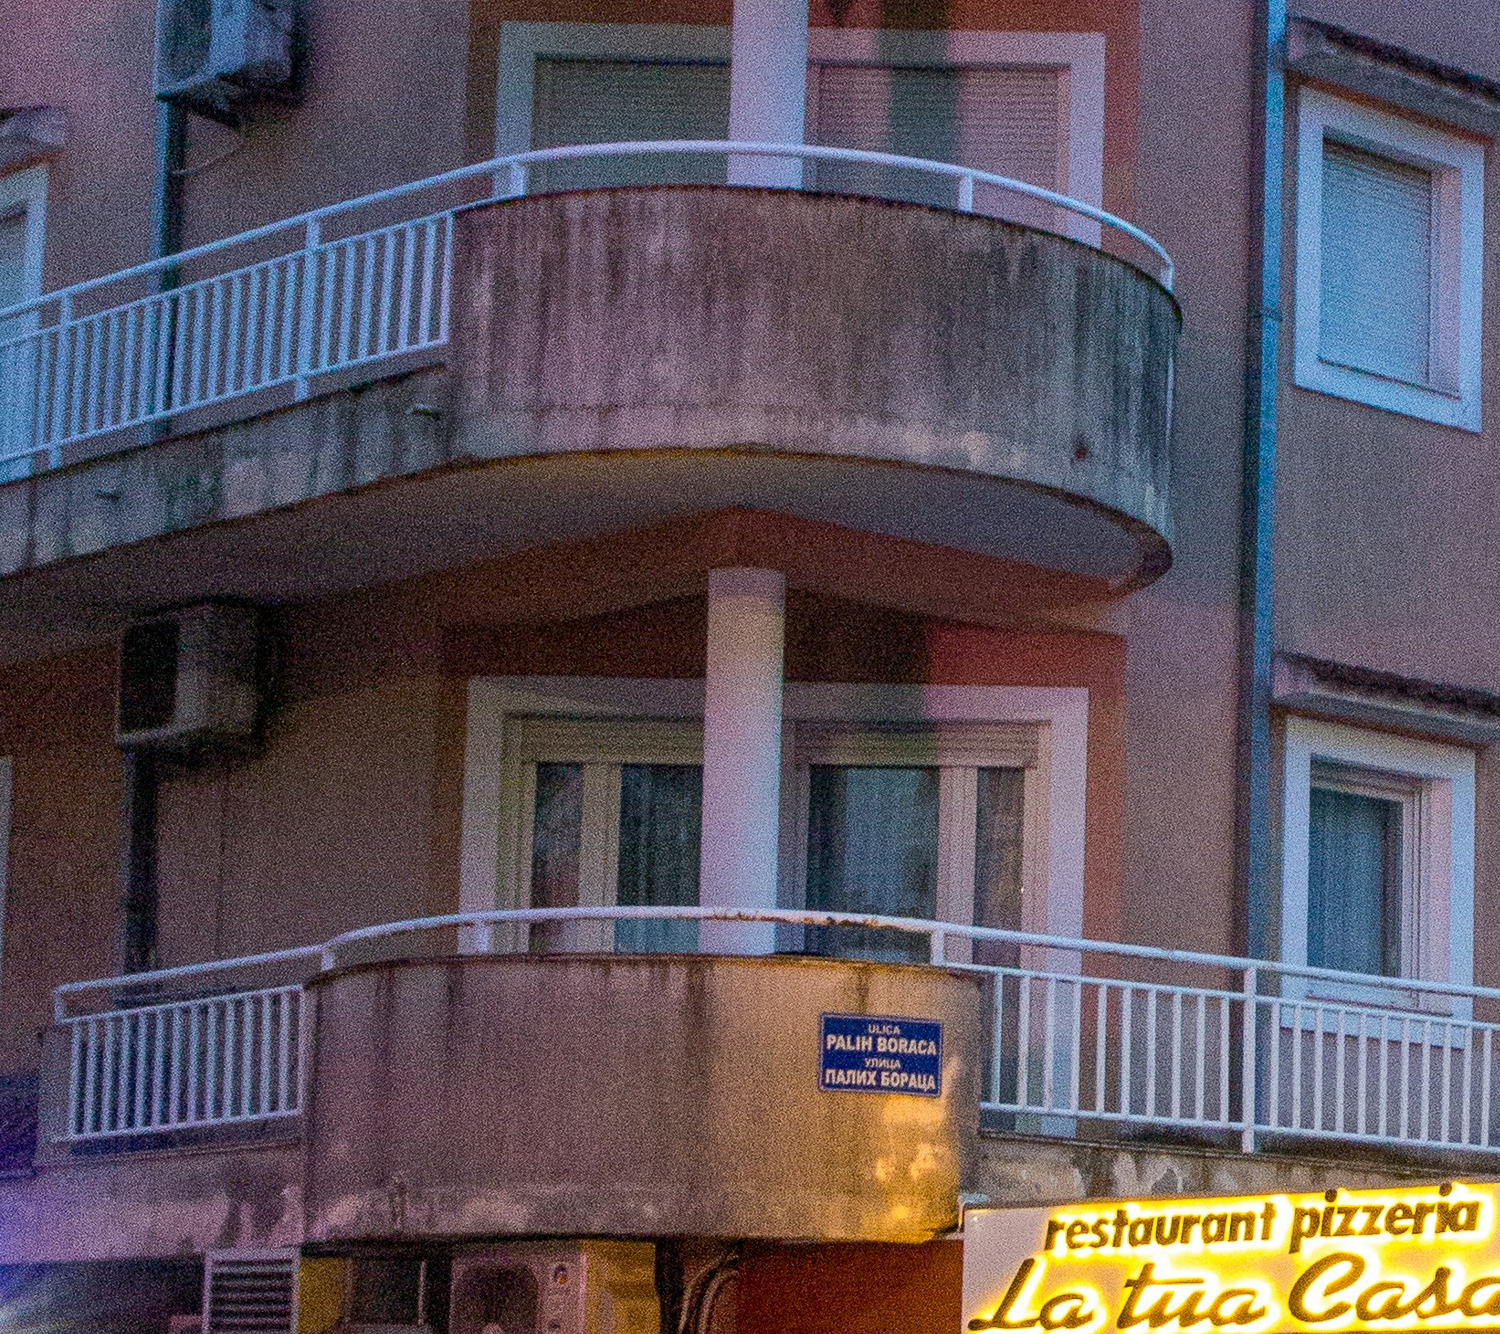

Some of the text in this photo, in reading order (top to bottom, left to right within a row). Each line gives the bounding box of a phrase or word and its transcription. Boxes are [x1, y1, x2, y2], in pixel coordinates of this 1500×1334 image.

[868, 1024, 900, 1035] ULICA
[826, 1034, 937, 1056] PALIH BORACA
[864, 1058, 901, 1070] УЛИЦА
[825, 1069, 936, 1092] ПАЛИХ БОРАЦА
[1045, 1183, 1483, 1254] restaurant pizzeria
[968, 1257, 1097, 1332] La
[1116, 1262, 1267, 1329] tua
